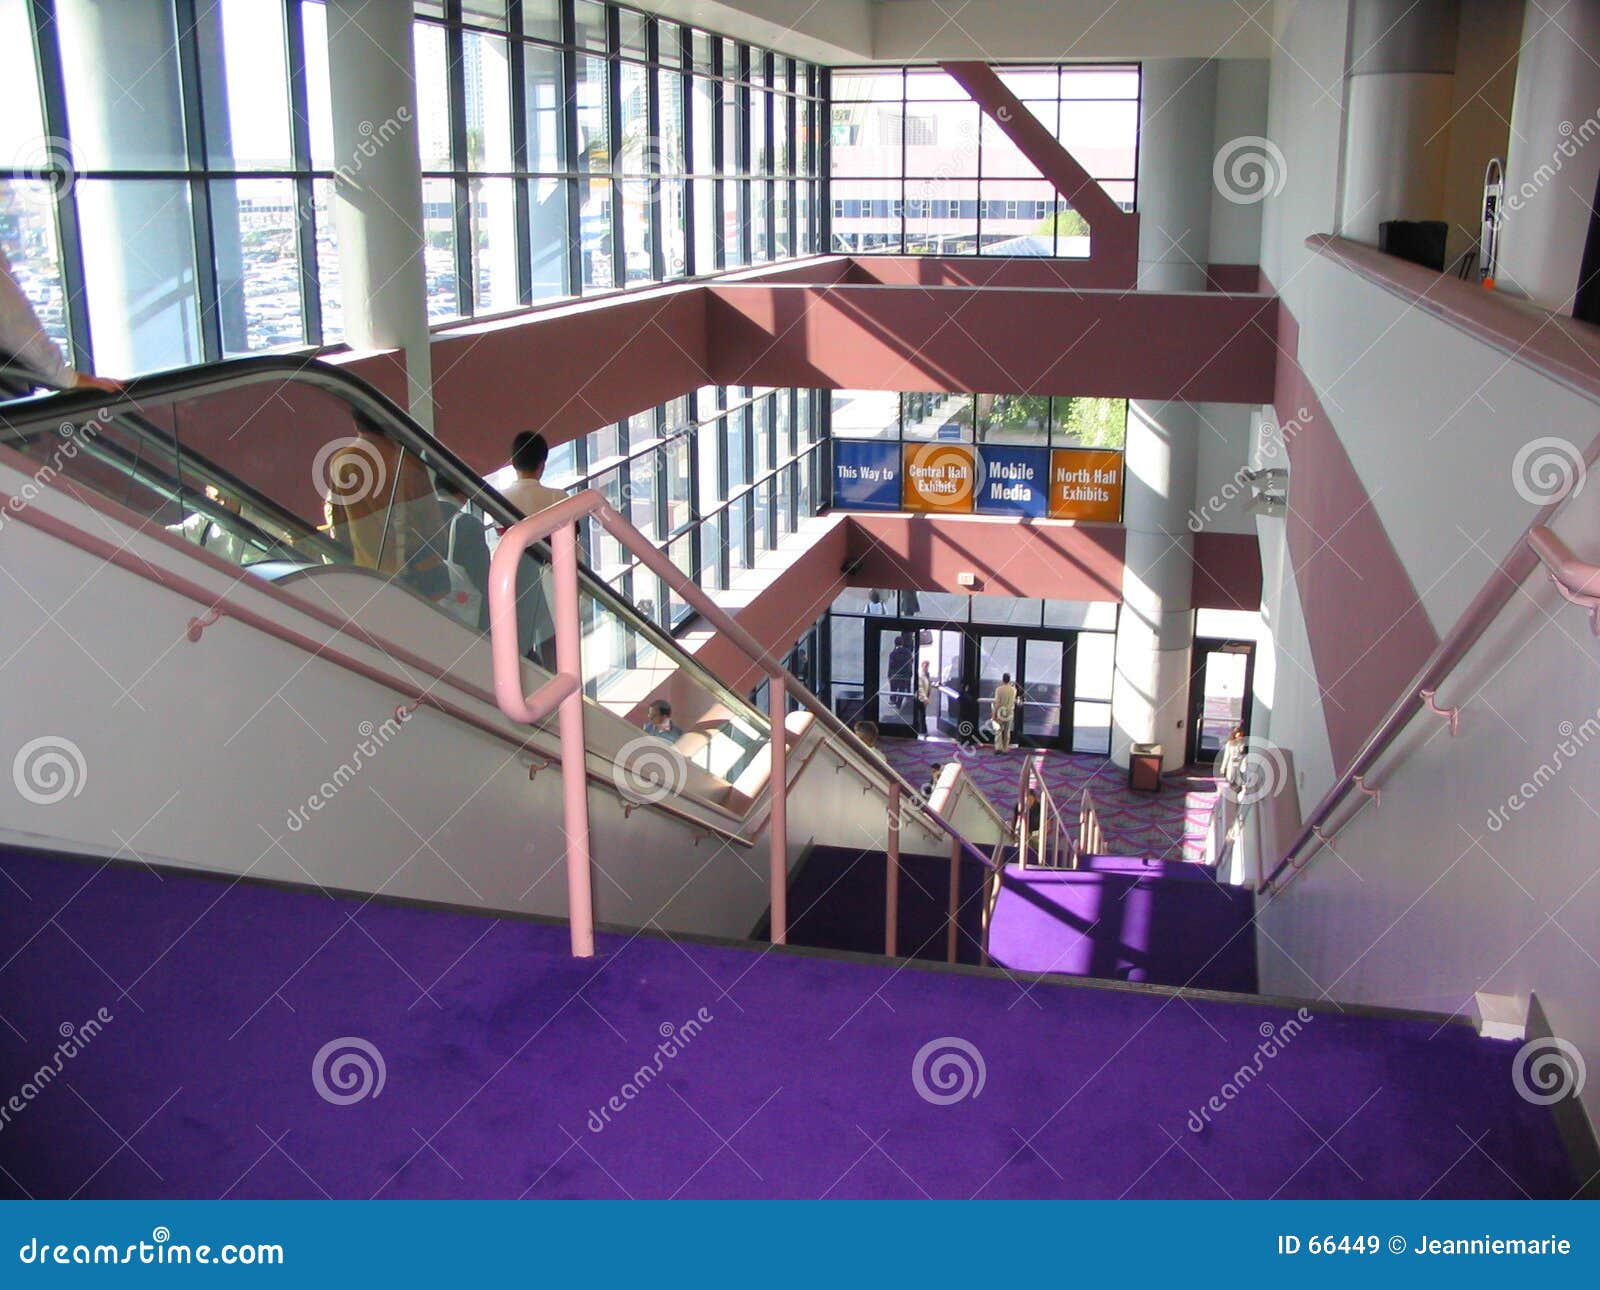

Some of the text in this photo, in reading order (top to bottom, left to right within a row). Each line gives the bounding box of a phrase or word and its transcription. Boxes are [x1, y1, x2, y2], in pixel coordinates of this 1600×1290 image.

[837, 465, 894, 482] This Way to
[909, 464, 968, 479] Central Hall
[989, 461, 1034, 480] Mobile
[1056, 468, 1117, 484] North Hall
[918, 480, 957, 494] Exhibits
[991, 483, 1031, 501] Media
[1063, 485, 1109, 502] Exhibits
